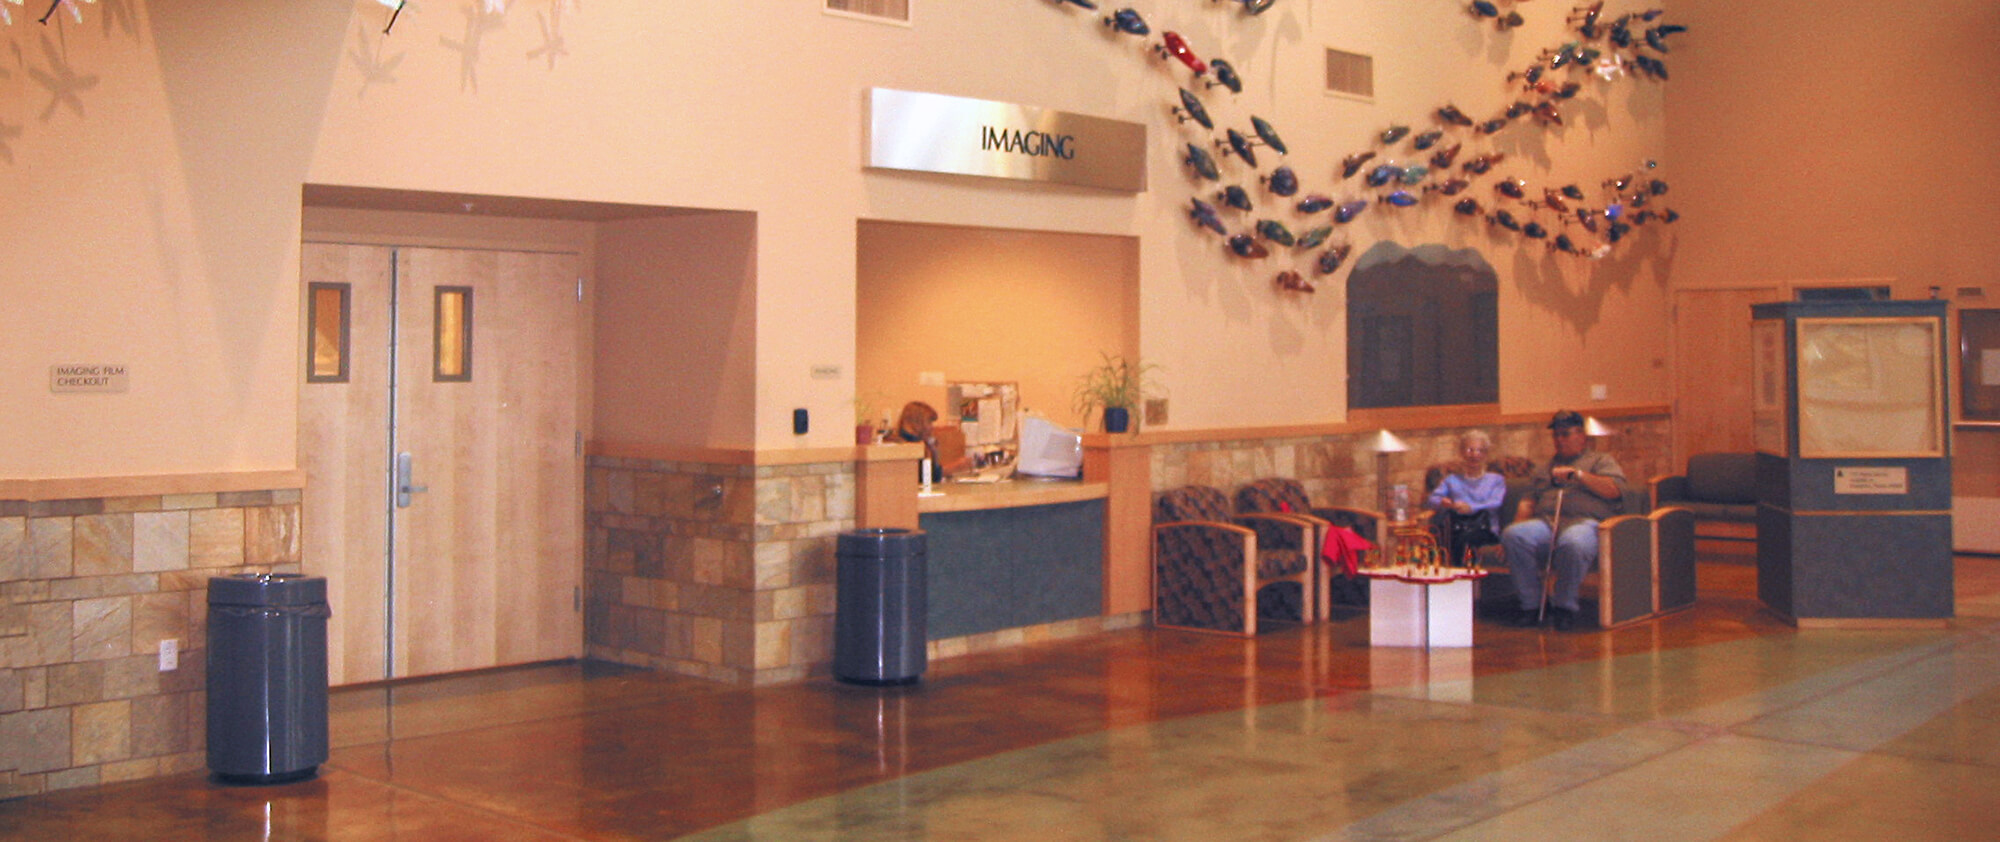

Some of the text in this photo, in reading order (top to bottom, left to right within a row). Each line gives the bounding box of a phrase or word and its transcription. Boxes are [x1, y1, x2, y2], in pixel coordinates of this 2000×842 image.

[982, 126, 1074, 160] IMAGING
[57, 366, 125, 376] IMAGING FILM
[57, 377, 109, 386] CHECKOUT
